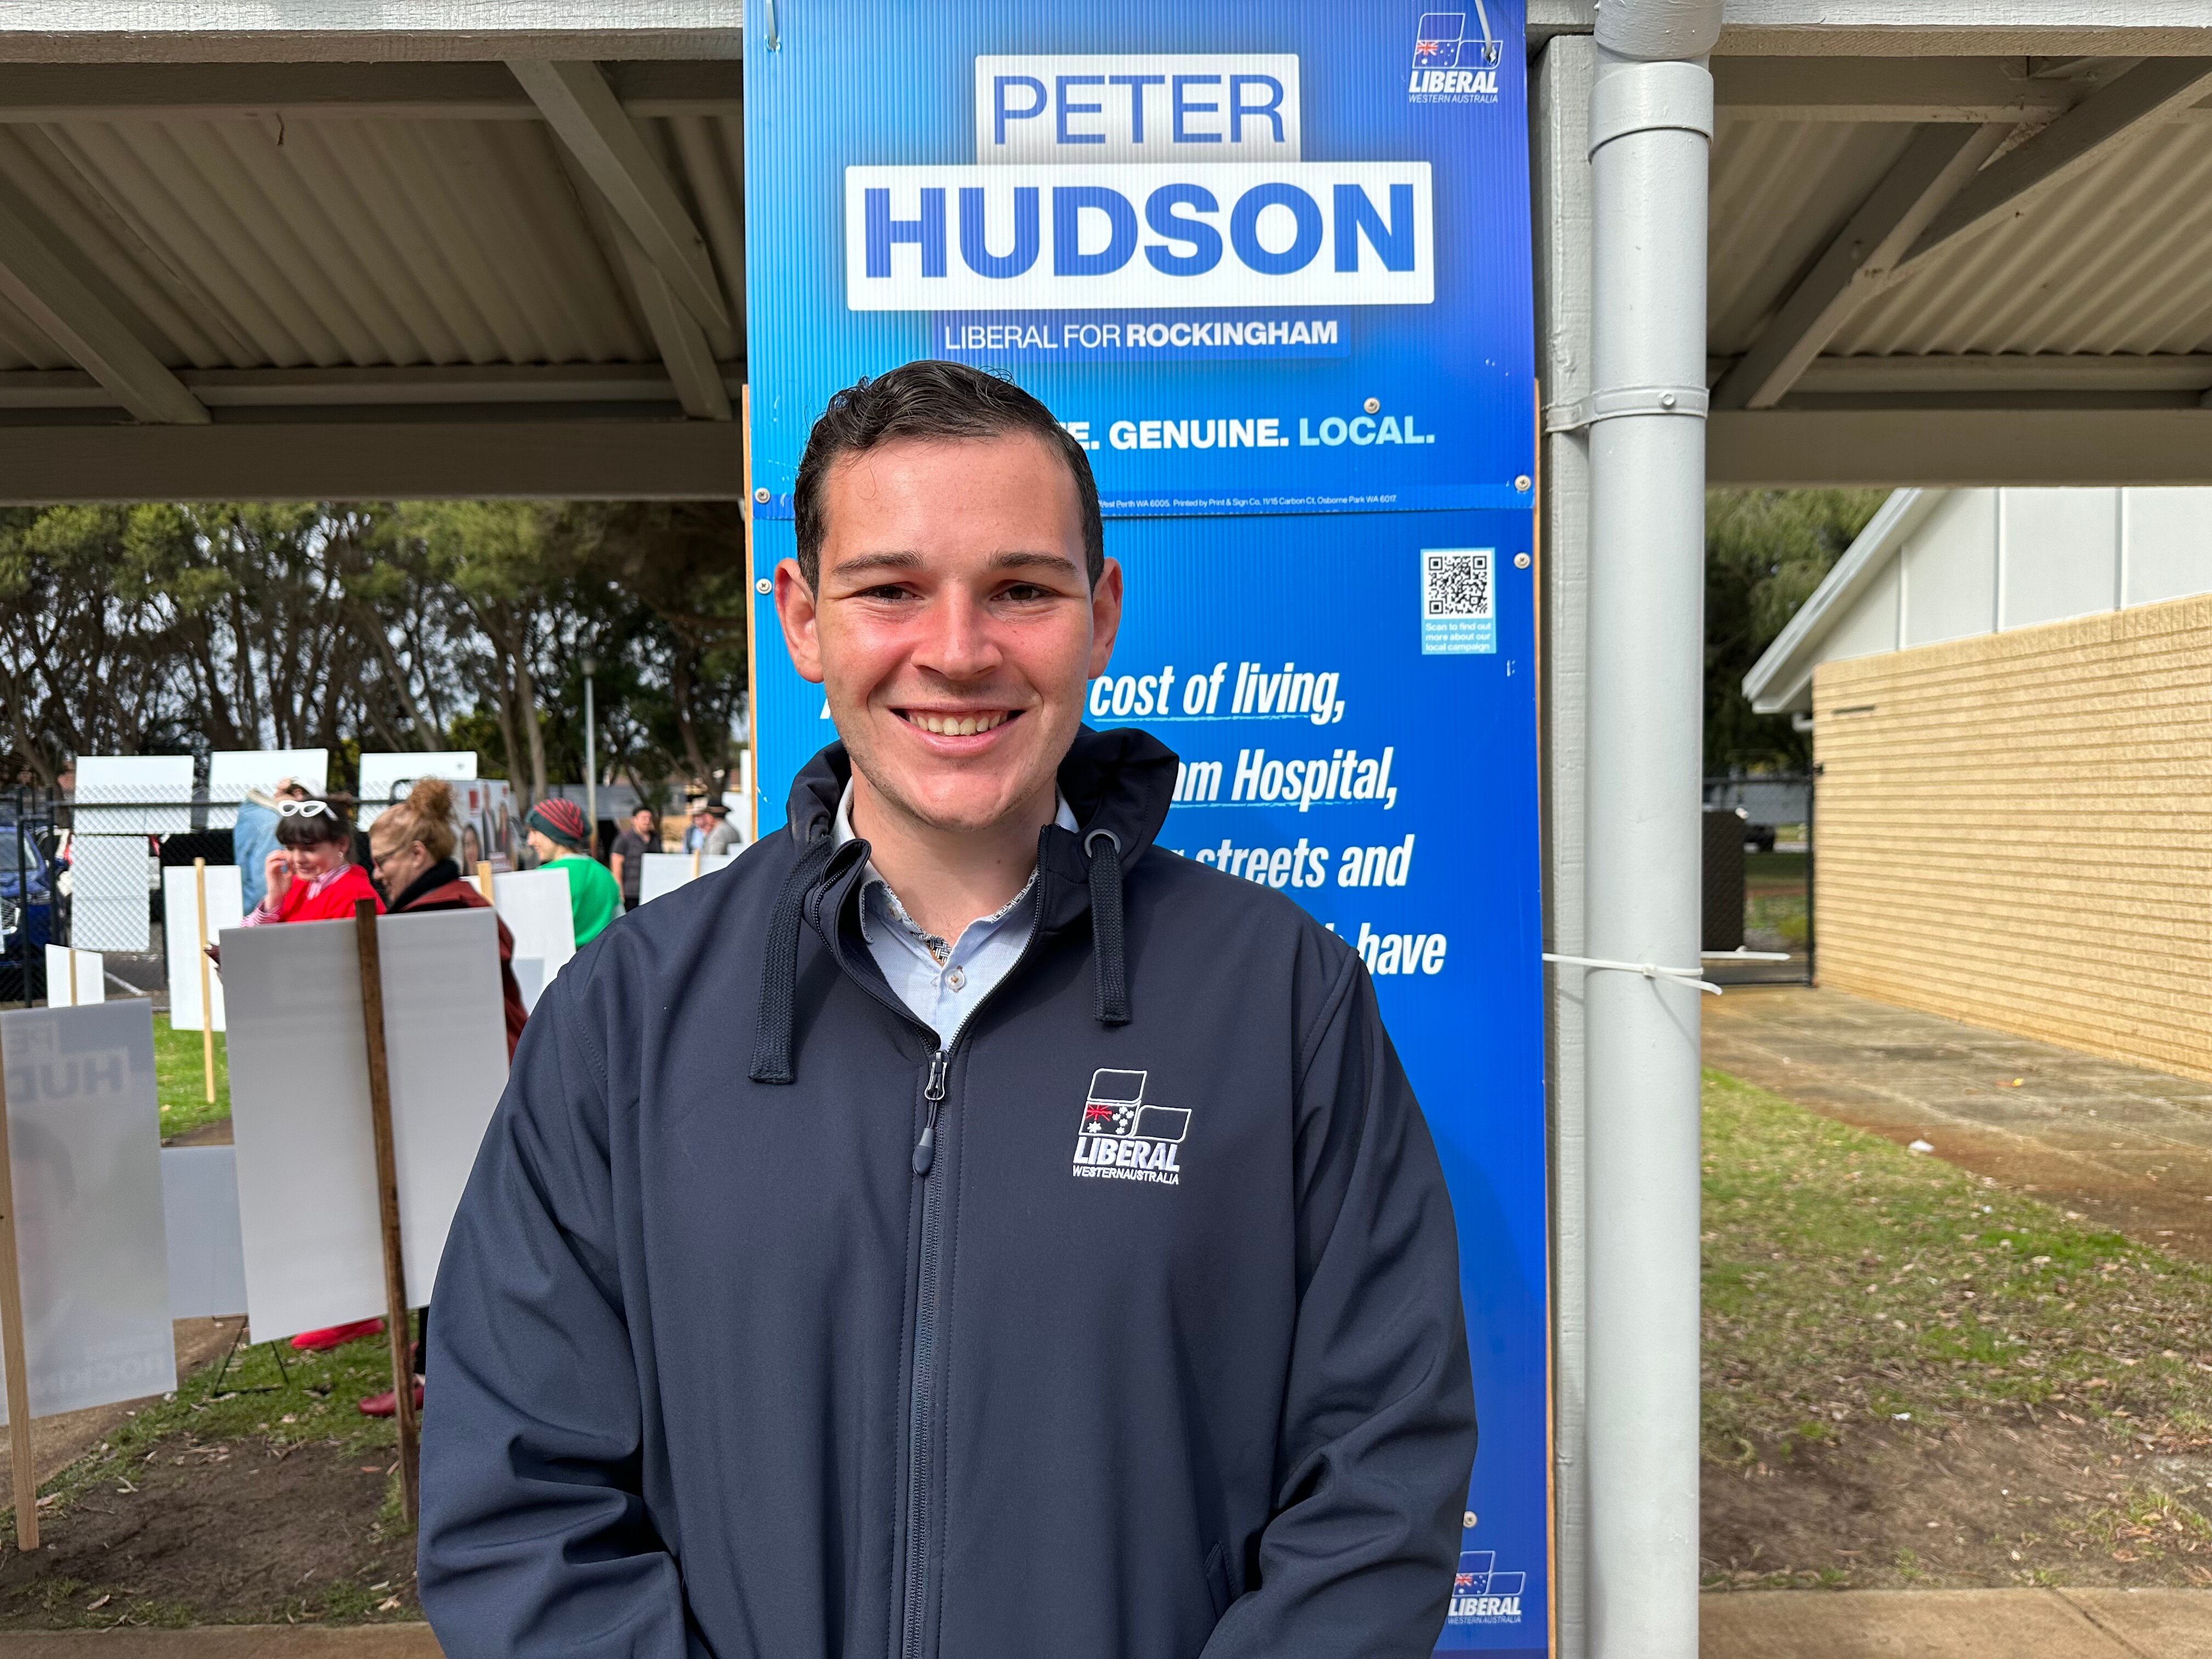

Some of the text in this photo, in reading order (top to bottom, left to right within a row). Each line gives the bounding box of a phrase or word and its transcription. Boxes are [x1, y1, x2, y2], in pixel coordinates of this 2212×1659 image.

[1408, 70, 1498, 93] LIBERAL
[994, 74, 1285, 145] PETER
[1408, 94, 1498, 104] WESTERN AUSTRALIA
[865, 182, 1415, 279] HUDSON
[945, 320, 1338, 349] LIBERAL FOR ROCKINGHAM
[1059, 416, 1435, 450] E. GENUINE. LOCAL.
[1199, 499, 1207, 508] by
[1233, 498, 1248, 507] Sign
[1317, 496, 1347, 504] Osborne
[1425, 623, 1447, 631] Scan
[1425, 643, 1491, 652] local campaign
[1090, 662, 1345, 725] cost of living,
[1231, 747, 1397, 812] Hospital,
[1337, 834, 1415, 887] and
[1356, 922, 1447, 975] have
[1073, 1137, 1180, 1172] LIBERAL
[1448, 1596, 1522, 1616] LIBERAL
[1448, 1615, 1522, 1624] WESTERN AUSTRALIA
